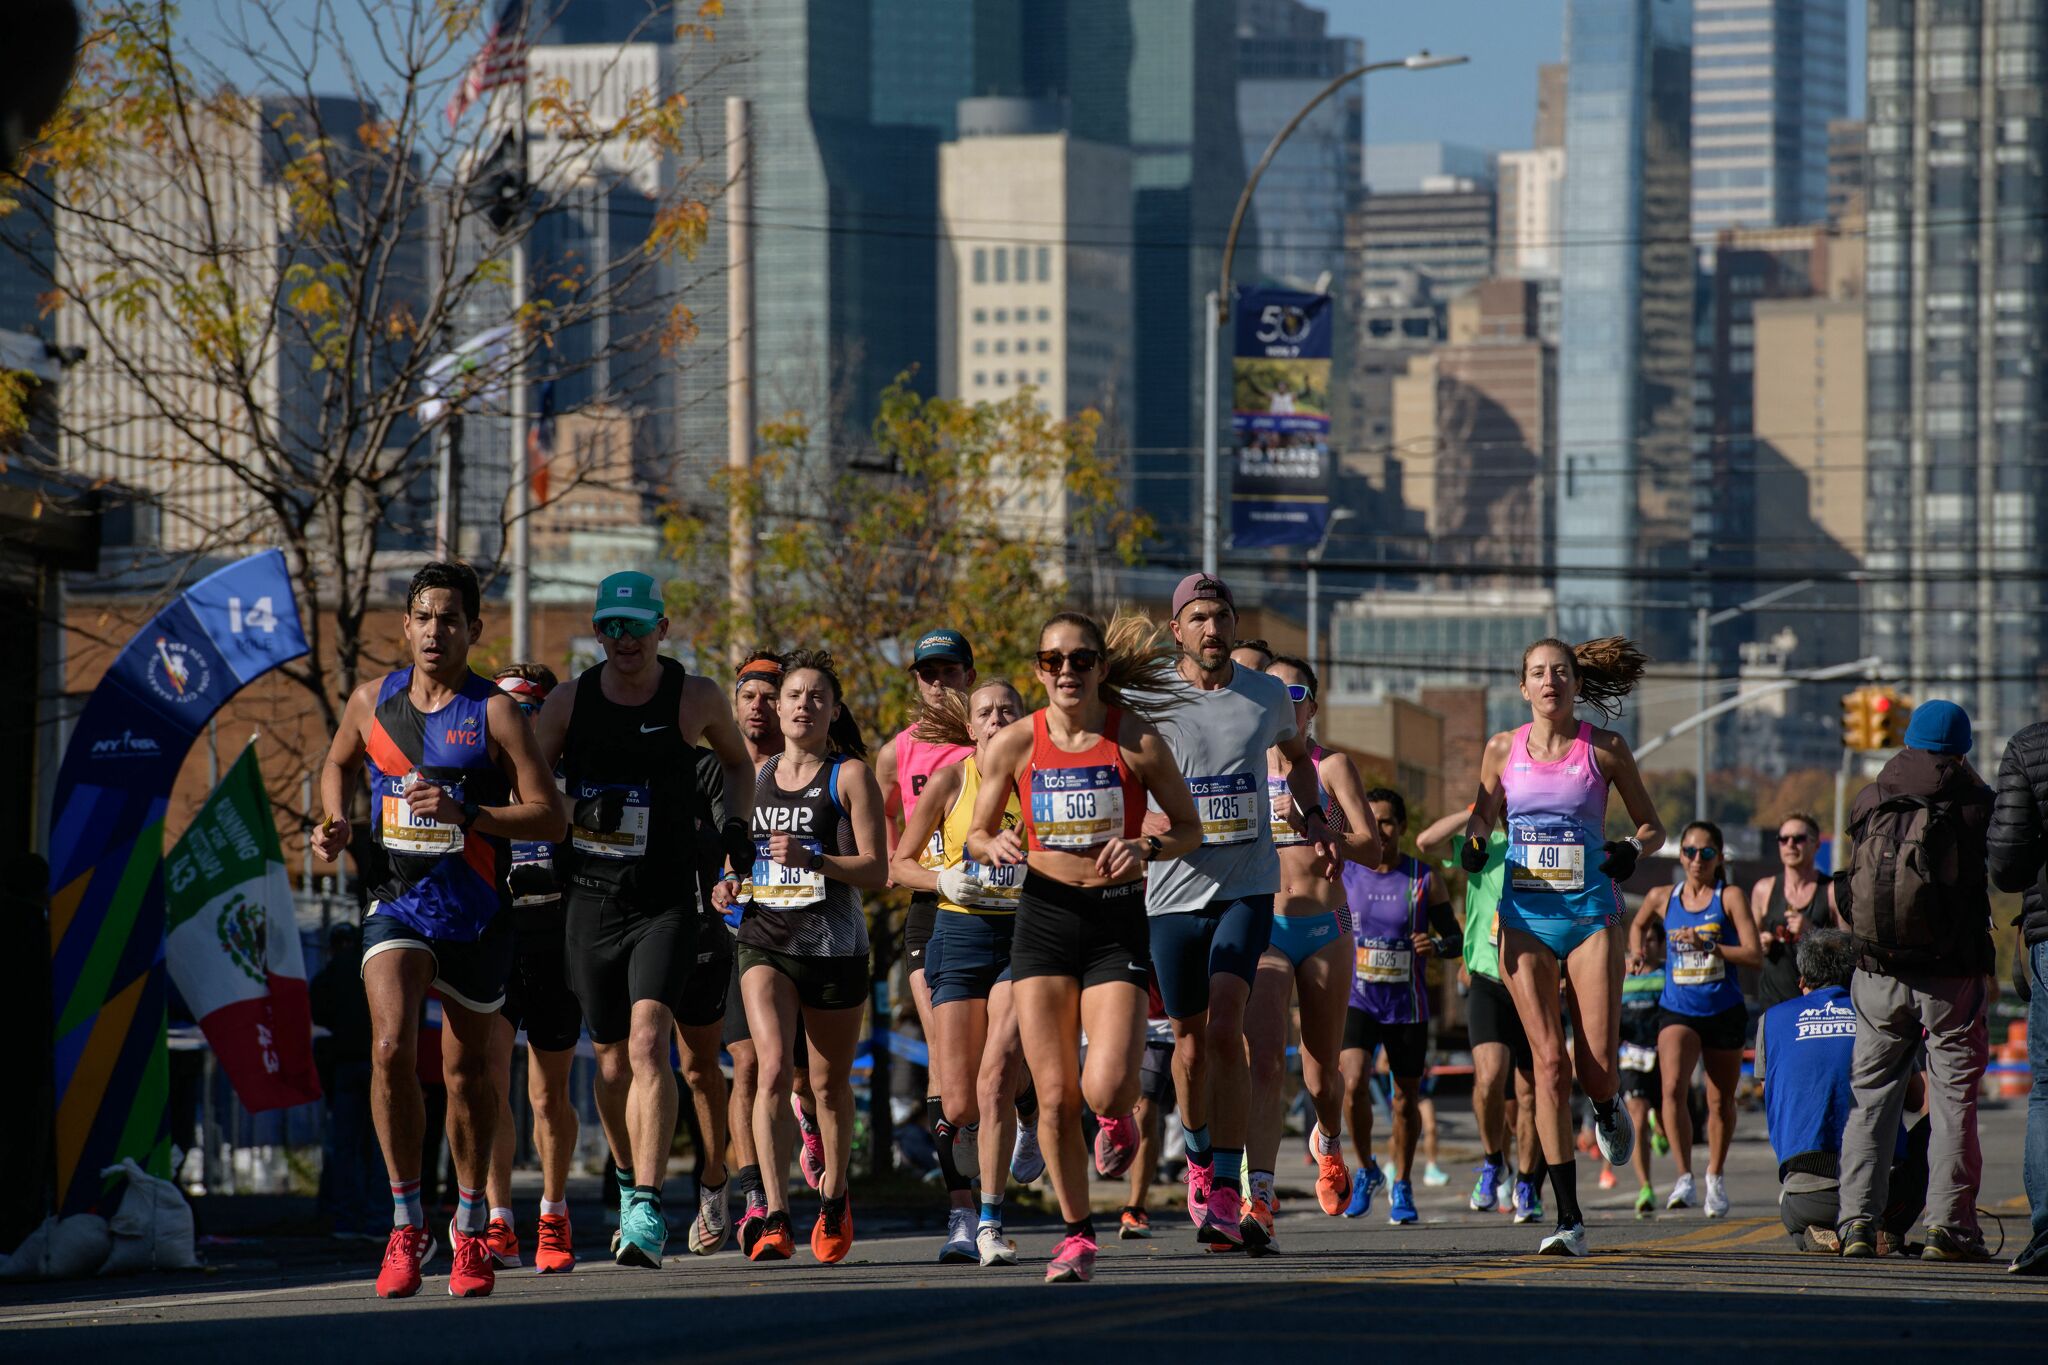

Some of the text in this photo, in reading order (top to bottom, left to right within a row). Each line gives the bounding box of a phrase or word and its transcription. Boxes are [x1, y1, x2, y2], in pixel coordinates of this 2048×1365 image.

[228, 596, 278, 634] 14
[446, 730, 477, 745] NYC
[392, 781, 406, 795] tc
[1044, 775, 1065, 788] tcs
[1190, 782, 1209, 794] tcs
[1066, 792, 1097, 819] 503
[1208, 796, 1239, 820] 1285
[753, 806, 813, 832] NBR
[1521, 829, 1537, 841] tcs
[760, 845, 772, 857] tc
[1538, 847, 1559, 868] 491
[169, 853, 197, 893] 43
[780, 864, 801, 885] 513
[989, 865, 1014, 887] 490
[1102, 882, 1145, 899] NIKE PR
[1375, 951, 1396, 968] 1525
[1799, 1022, 1857, 1037] PHOTO
